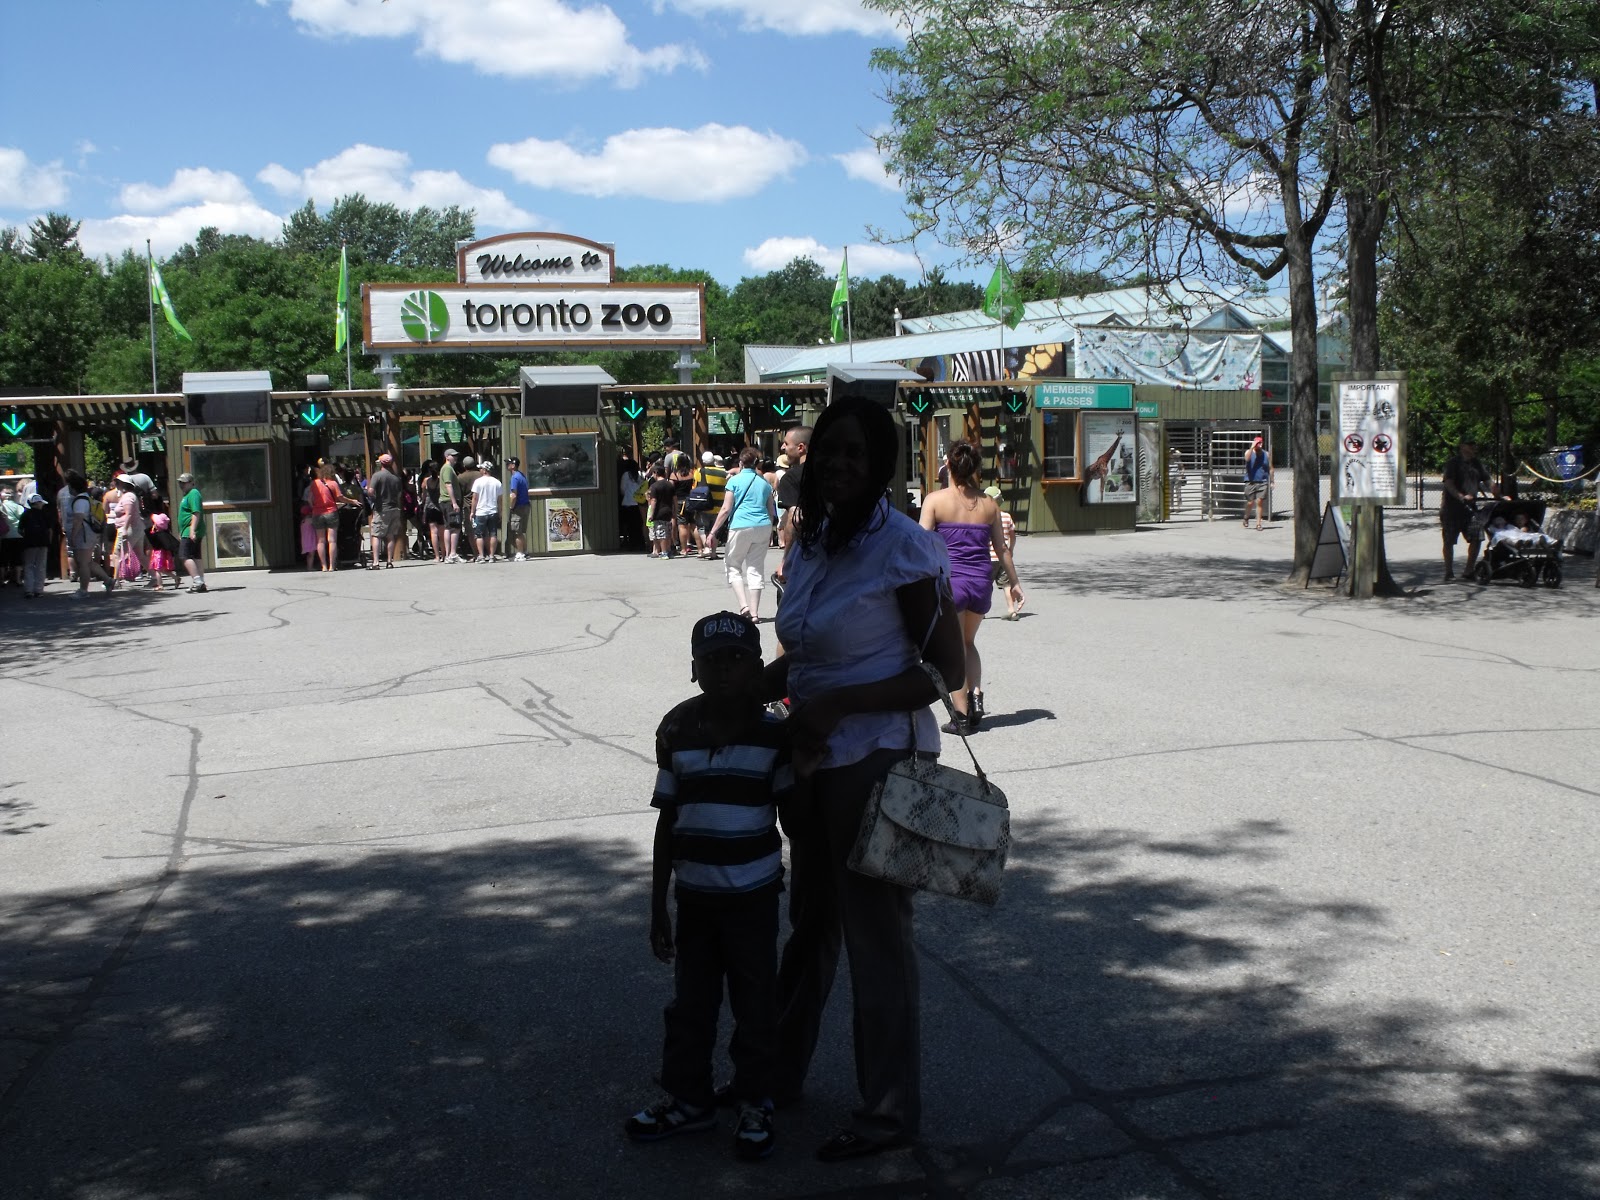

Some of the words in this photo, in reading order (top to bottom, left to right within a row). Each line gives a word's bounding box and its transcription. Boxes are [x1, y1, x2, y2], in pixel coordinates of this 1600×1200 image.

[476, 252, 573, 275] Welcome
[581, 250, 602, 268] to
[462, 299, 591, 328] toronto
[601, 303, 671, 326] zoo
[1042, 385, 1095, 394] MEMBERS
[1043, 396, 1051, 406] &
[1053, 396, 1093, 406] PASSES
[704, 618, 746, 637] GAP
